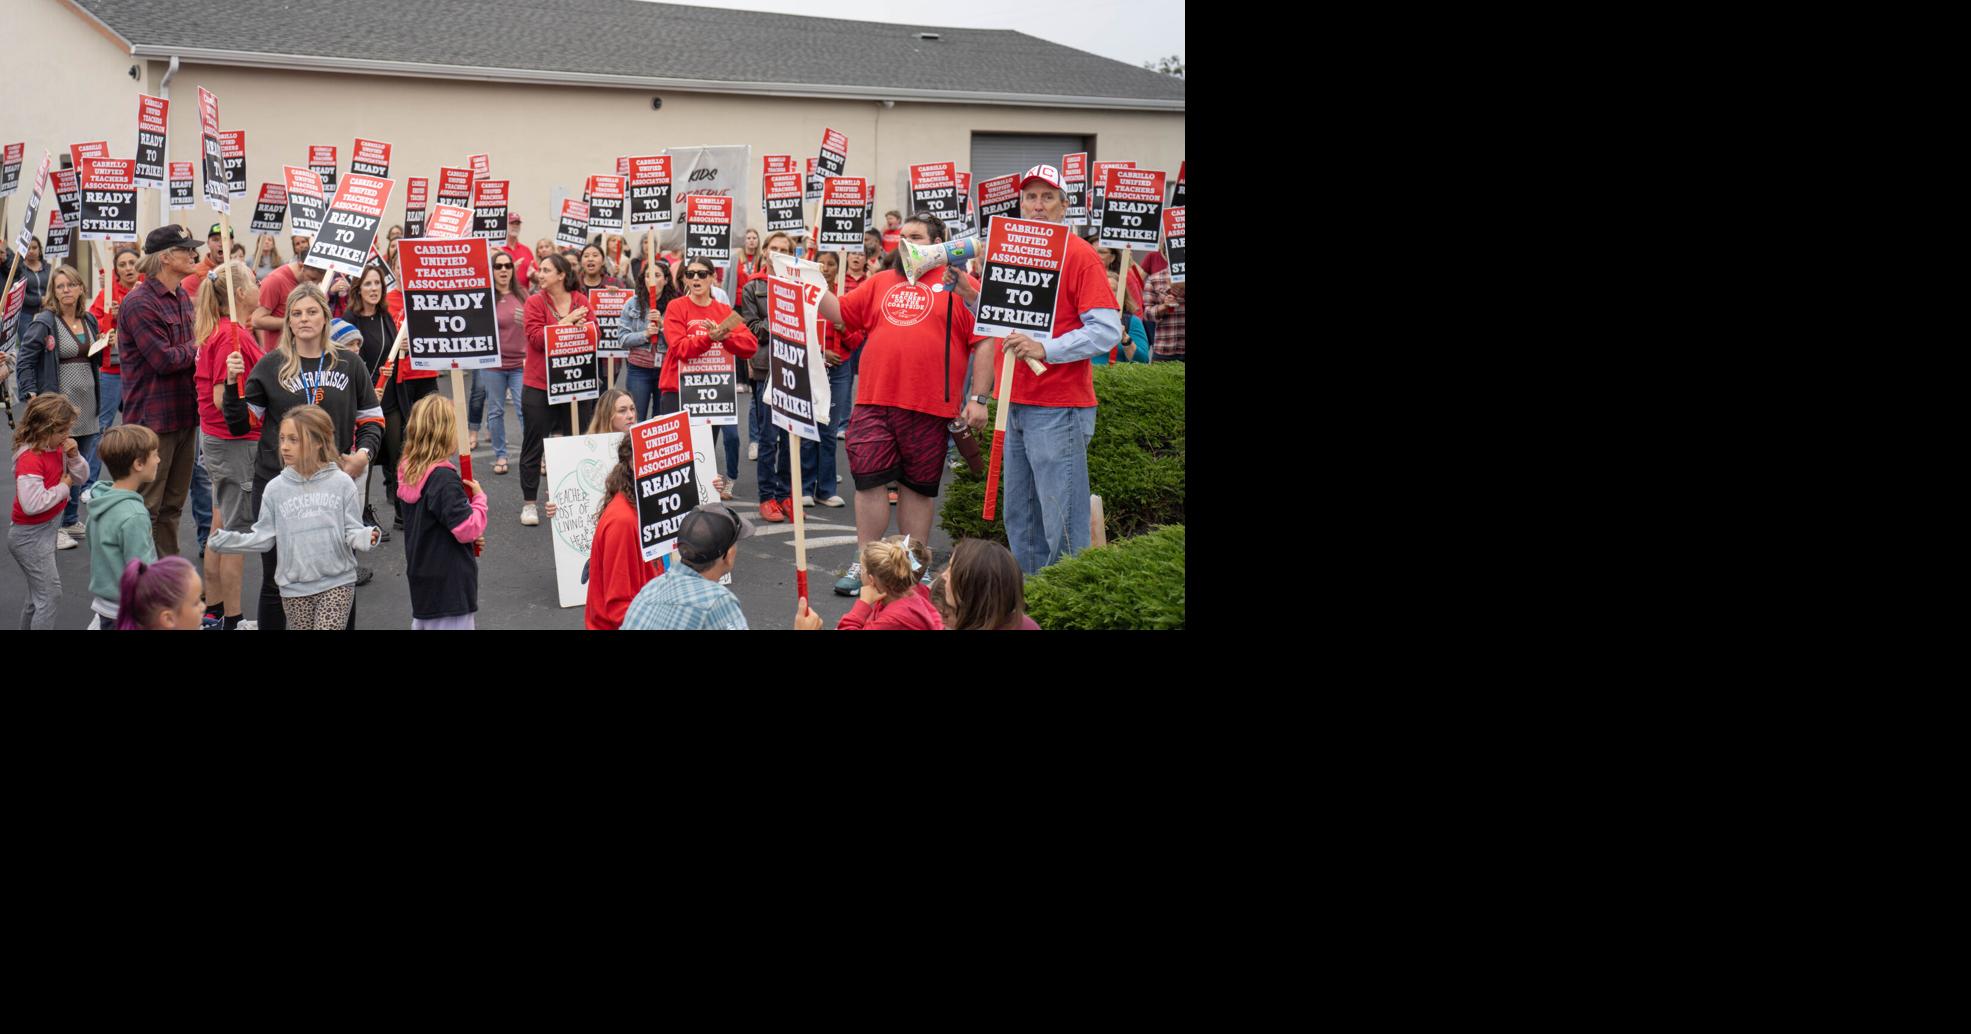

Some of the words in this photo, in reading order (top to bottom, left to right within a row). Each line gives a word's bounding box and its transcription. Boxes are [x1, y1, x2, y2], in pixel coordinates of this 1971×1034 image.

[140, 132, 164, 148] READY
[146, 149, 156, 162] TO
[92, 161, 128, 169] CABRILLO
[137, 163, 163, 177] STRIKE!
[354, 163, 386, 175] READY
[827, 161, 836, 171] TO
[95, 168, 125, 176] UNIFIED
[688, 168, 718, 182] KIDS
[1117, 171, 1156, 180] CABRILLO
[90, 175, 129, 183] TEACHERS
[349, 178, 384, 189] CABRILLO
[1120, 178, 1152, 187] UNIFIED
[634, 186, 669, 198] READY
[916, 188, 954, 200] READY
[1115, 185, 1155, 194] TEACHERS
[86, 192, 133, 204] READY
[291, 195, 322, 208] READY
[342, 193, 379, 205] TEACHERS
[1108, 191, 1161, 201] ASSOCIATION
[258, 204, 285, 213] READY
[592, 199, 622, 208] READY
[644, 199, 659, 210] TO
[769, 199, 801, 209] READY
[928, 201, 944, 210] TO
[983, 199, 1018, 215] READY
[1109, 201, 1158, 214] READY
[99, 206, 119, 218] TO
[264, 213, 275, 221] TO
[303, 208, 316, 218] TO
[477, 208, 506, 217] READY
[600, 209, 612, 217] TO
[632, 210, 671, 222] STRIKE!
[779, 210, 792, 219] TO
[827, 207, 863, 218] READY
[83, 219, 134, 231] STRIKE!
[328, 211, 377, 230] READY
[485, 219, 497, 229] TO
[769, 219, 803, 230] STRIKE!
[836, 220, 852, 230] TO
[1121, 215, 1142, 227] TO
[411, 225, 420, 235] TO
[568, 226, 579, 235] TO
[690, 224, 728, 235] READY
[1006, 222, 1054, 238] CABRILLO
[1103, 227, 1157, 240] STRIKE!
[335, 229, 355, 244] TO
[701, 237, 717, 247] TO
[823, 232, 863, 242] STRIKE!
[1008, 233, 1048, 247] UNIFIED
[313, 241, 366, 263] STRIKE!
[414, 245, 472, 255] CABRILLO
[687, 248, 729, 258] STRIKE!
[1001, 242, 1052, 258] TEACHERS
[420, 256, 468, 266] UNIFIED
[991, 252, 1058, 269] ASSOCIATION
[415, 267, 476, 278] TEACHERS
[991, 266, 1055, 288] READY
[408, 278, 486, 289] ASSOCIATION
[412, 293, 485, 311] READY
[1006, 289, 1032, 306] TO
[981, 305, 1051, 326] STRIKE!
[435, 316, 466, 333] TO
[603, 329, 619, 338] TO
[413, 336, 494, 354] STRIKE!
[555, 339, 589, 348] TEACHERS
[551, 345, 594, 355] ASSOCIATION
[773, 339, 805, 368] READY
[553, 354, 593, 368] READY
[683, 364, 731, 372] ASSOCIATION
[564, 369, 582, 380] TO
[685, 374, 731, 386] READY
[782, 367, 795, 390] TO
[551, 379, 596, 394] STRIKE!
[698, 389, 718, 400] TO
[683, 402, 734, 414] STRIKE!
[772, 389, 812, 420] STRIKE!
[641, 420, 680, 438] CABRILLO
[646, 433, 678, 449] UNIFIED
[643, 442, 684, 462] TEACHERS
[639, 451, 691, 476] ASSOCIATION
[642, 465, 691, 498] READY
[579, 502, 592, 515] OF
[659, 494, 681, 515] TO
[558, 516, 583, 533] LIVING
